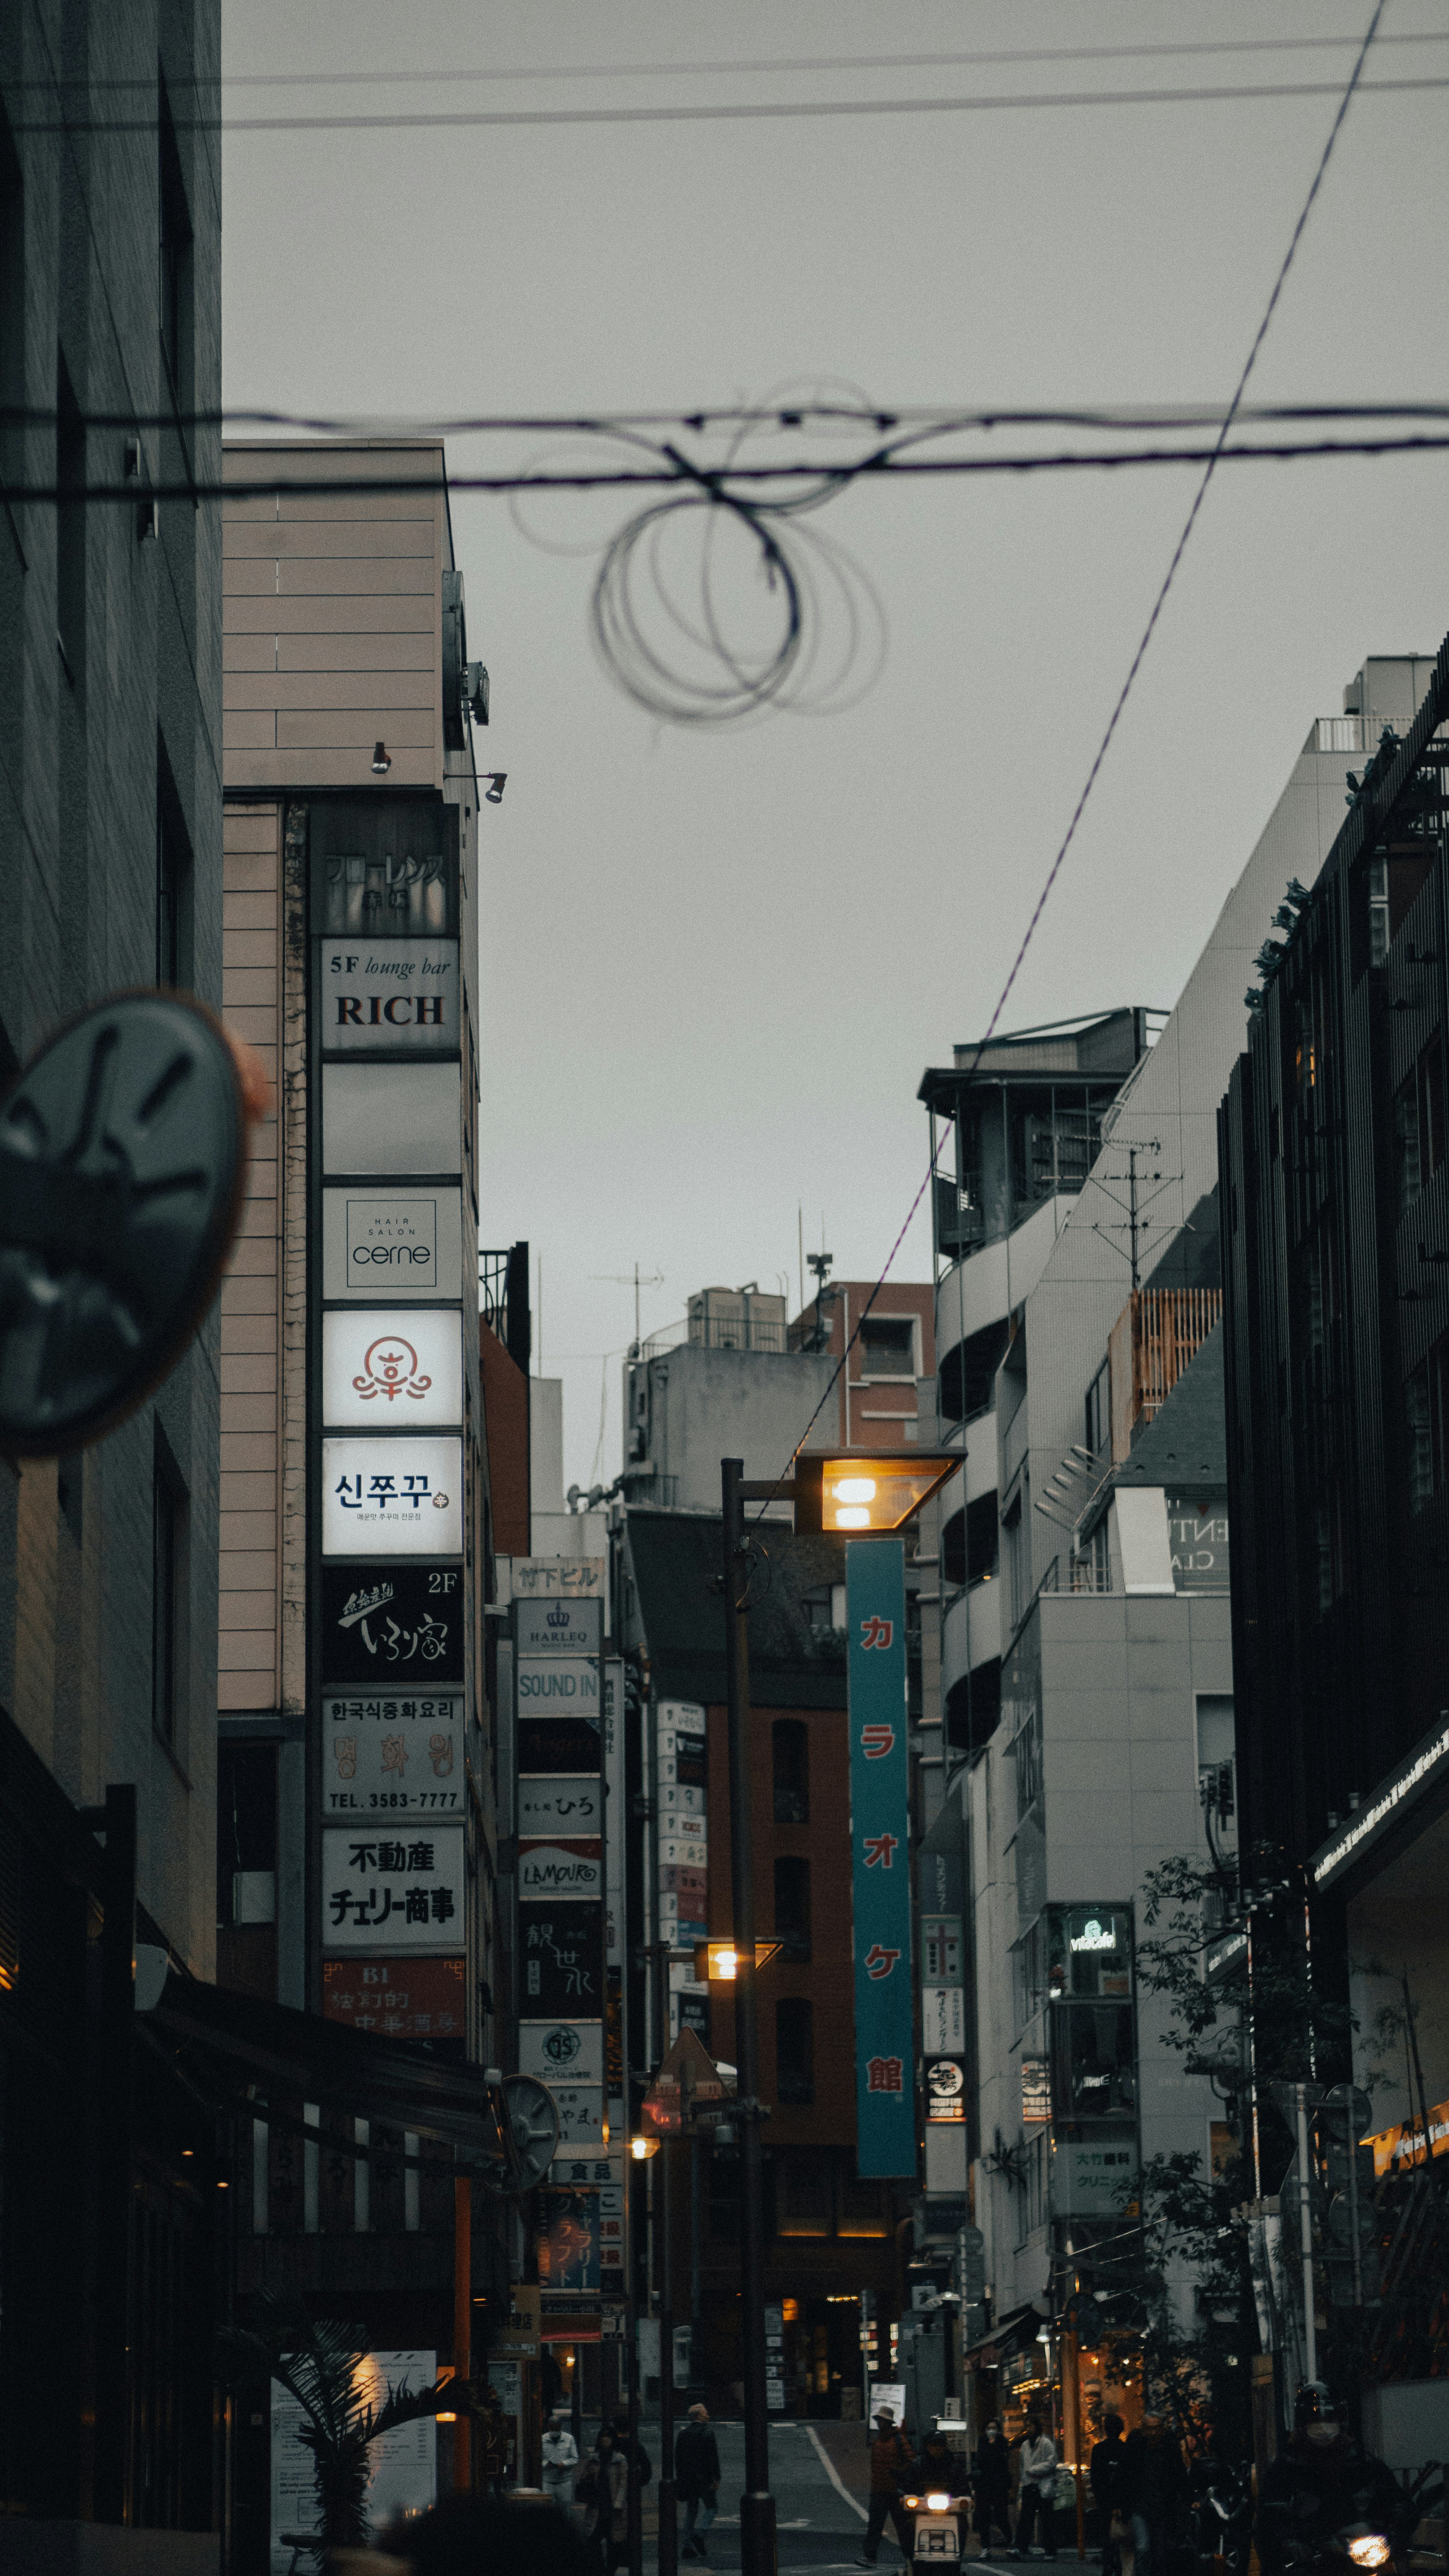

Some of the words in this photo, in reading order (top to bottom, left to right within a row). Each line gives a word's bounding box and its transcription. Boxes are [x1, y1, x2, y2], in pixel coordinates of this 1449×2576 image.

[330, 957, 359, 973] 5F
[365, 957, 415, 979] lounge
[422, 958, 450, 974] bar
[335, 996, 445, 1025] RICH
[353, 1246, 430, 1264] cerne
[335, 1474, 432, 1508] 신쭈꾸
[429, 1573, 457, 1593] 2F
[519, 1567, 597, 1588] 竹下ビル
[361, 1613, 448, 1660] いろり家
[531, 1632, 586, 1643] HARLEQ
[520, 1674, 576, 1697] SOUND
[581, 1674, 596, 1696] IN
[331, 1701, 454, 1720] 한국식중화요리
[330, 1793, 364, 1807] TEL.
[370, 1793, 457, 1807] 3583-7777
[556, 1797, 594, 1815] ひろ
[349, 1841, 434, 1873] 不動産
[861, 1614, 903, 2093] カラオケ館
[330, 1886, 455, 1926] チェリー商事
[571, 2163, 611, 2180] 食品
